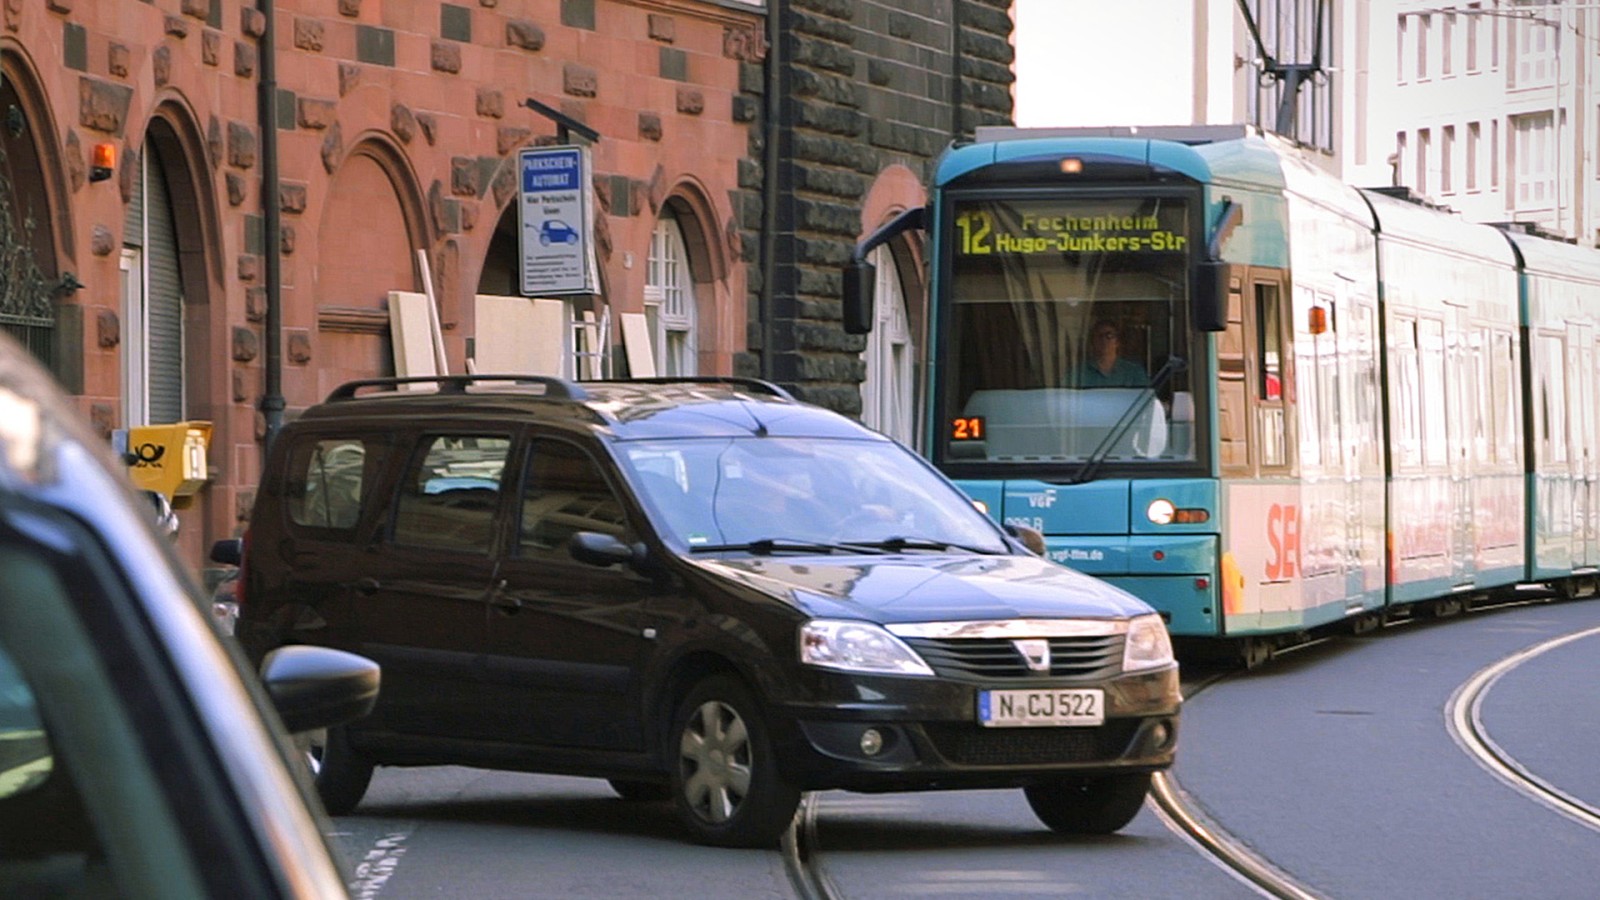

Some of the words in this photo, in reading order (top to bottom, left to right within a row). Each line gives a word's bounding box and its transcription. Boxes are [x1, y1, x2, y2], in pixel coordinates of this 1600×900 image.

[956, 210, 991, 254] 12
[1022, 213, 1159, 231] Fechenheim
[995, 231, 1187, 253] Hugo-Junkers-Str
[953, 418, 980, 438] 21
[1000, 694, 1013, 717] N
